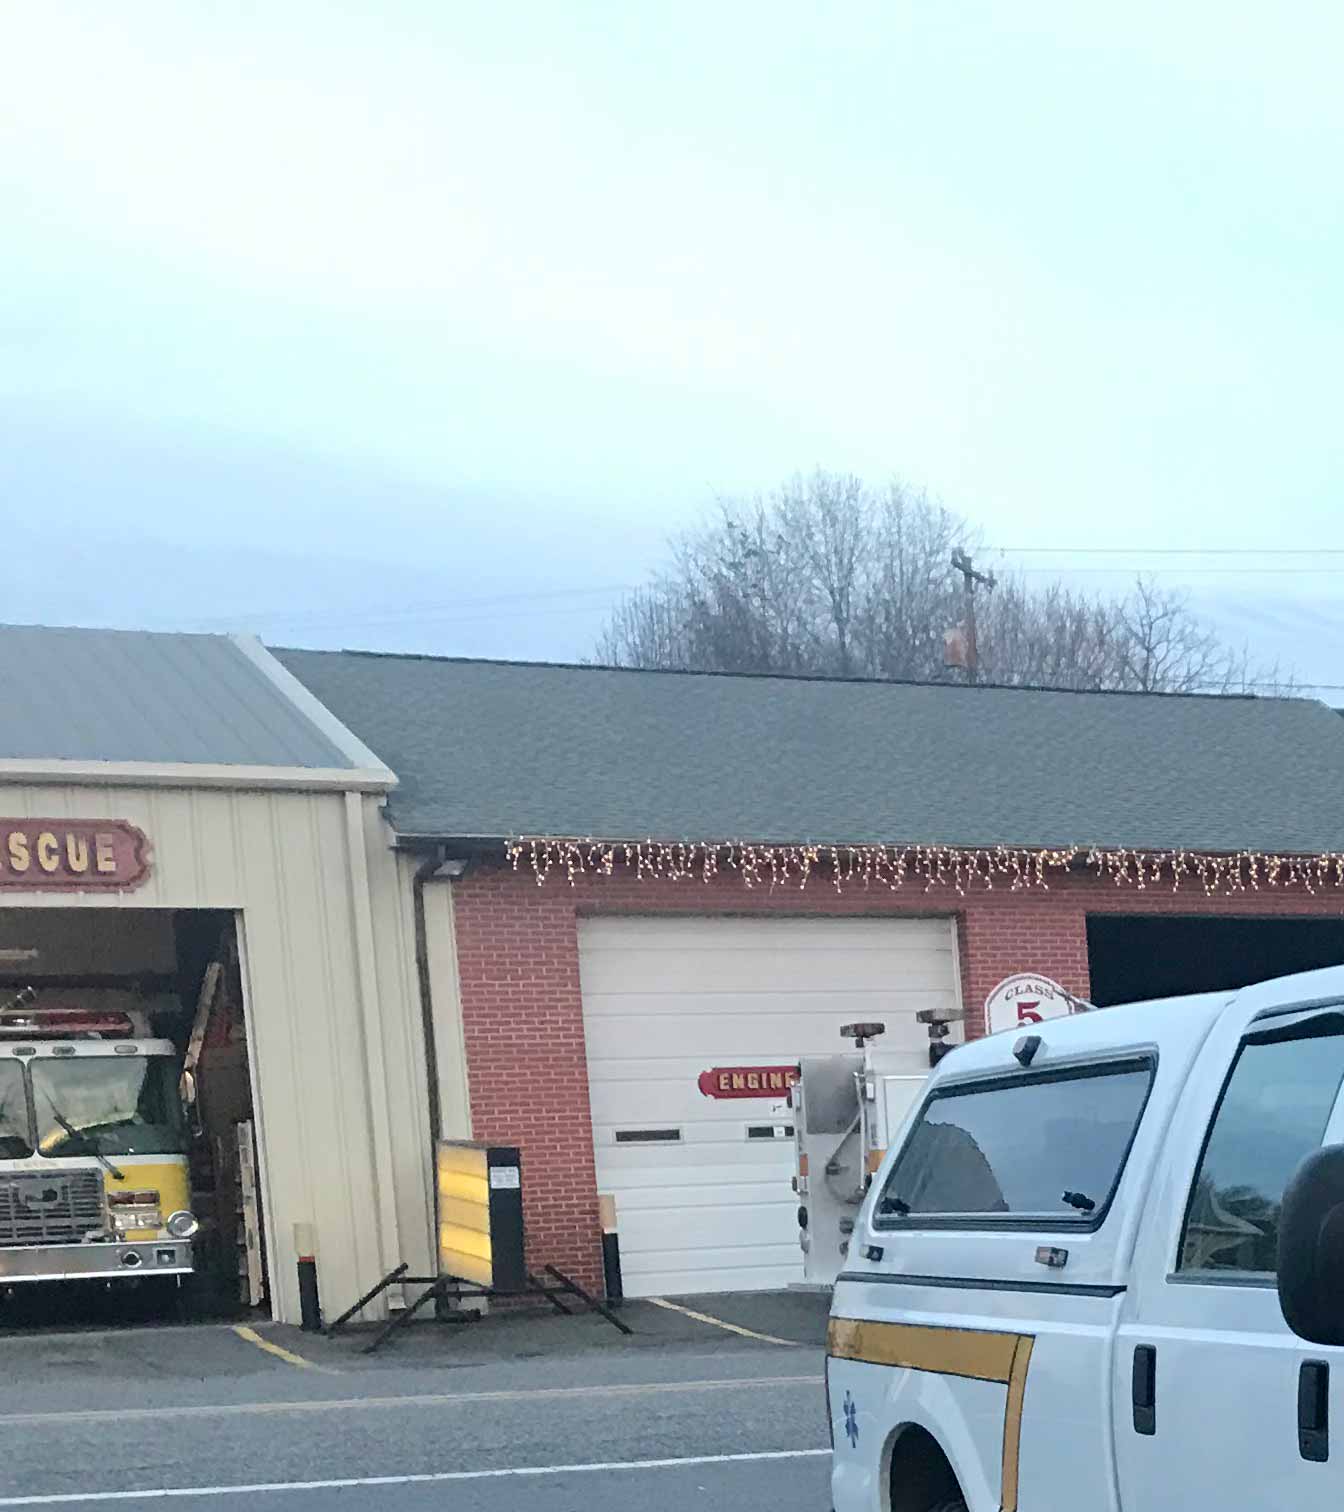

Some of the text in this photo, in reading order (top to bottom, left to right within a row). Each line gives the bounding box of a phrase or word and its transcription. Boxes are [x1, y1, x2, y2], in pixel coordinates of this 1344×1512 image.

[0, 831, 117, 872] SCUE
[1004, 983, 1054, 1001] CLASS
[1017, 1001, 1043, 1027] 5
